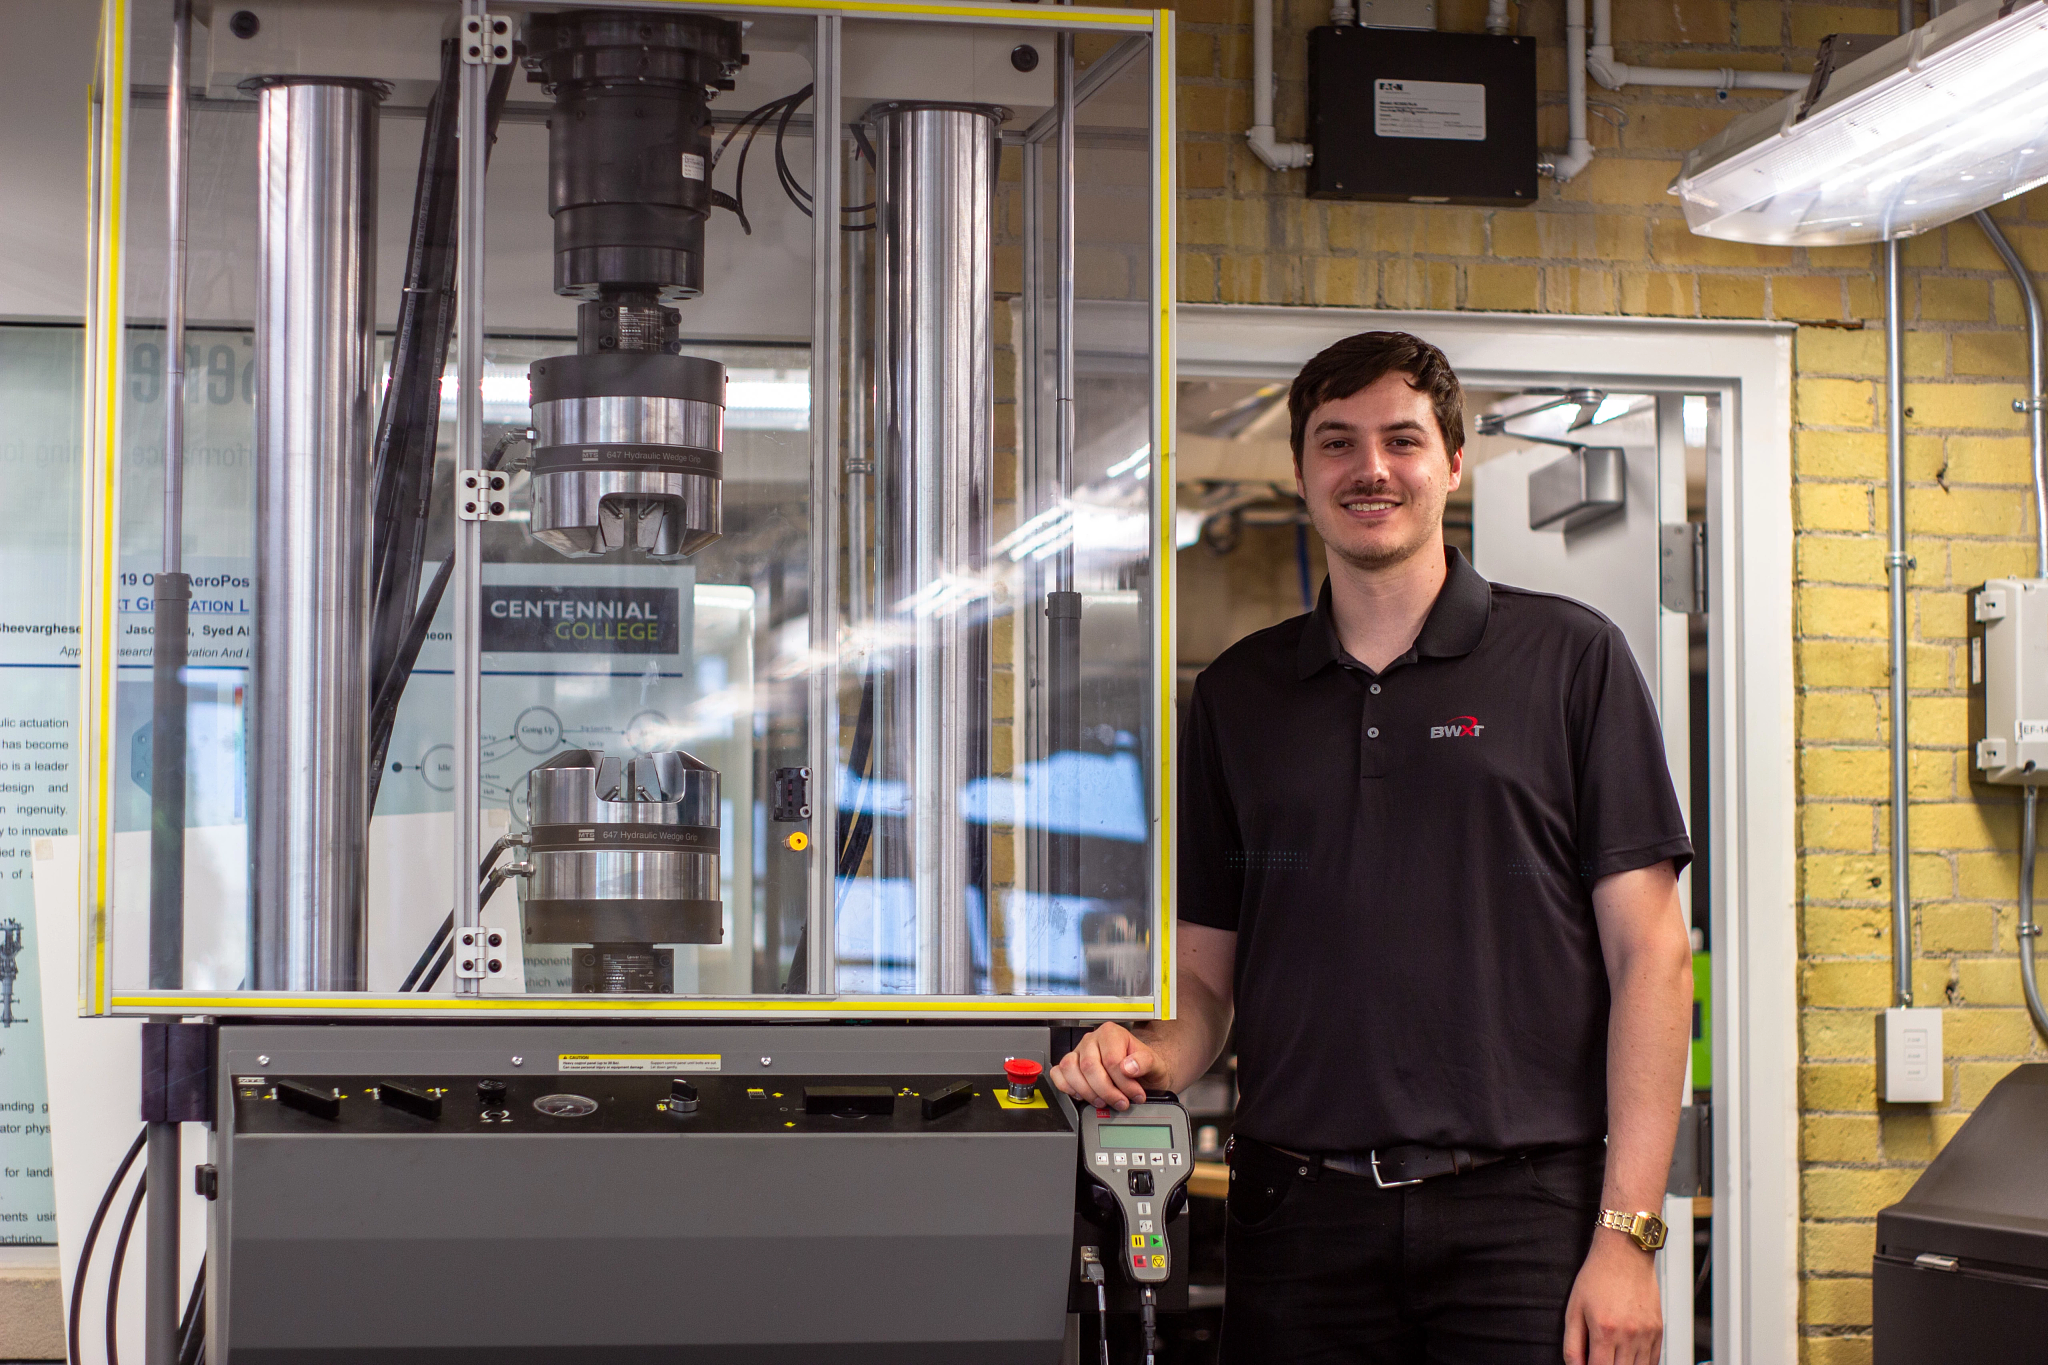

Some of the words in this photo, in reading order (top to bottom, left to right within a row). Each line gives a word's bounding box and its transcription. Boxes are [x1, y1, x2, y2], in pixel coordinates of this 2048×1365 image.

[582, 451, 598, 459] MTS
[606, 451, 621, 459] 647
[624, 451, 661, 461] Hydraulic
[662, 451, 687, 463] Wedge
[688, 454, 701, 465] Grip
[490, 599, 658, 619] CENTENNIAL
[202, 625, 233, 638] Syed
[555, 621, 658, 641] COLLEGE
[221, 647, 244, 659] And
[19, 717, 69, 729] actuation
[1430, 718, 1484, 739] BWXT
[2, 739, 21, 751] has
[25, 739, 69, 751] become
[12, 760, 21, 772] is
[24, 762, 31, 772] a
[34, 760, 69, 772] leader
[48, 782, 69, 793] and
[17, 803, 68, 817] ingenuity.
[8, 825, 19, 836] to
[21, 825, 69, 836] innovate
[578, 831, 595, 839] MTS
[602, 830, 618, 839] 647
[620, 830, 657, 842] Hydraulic
[659, 831, 683, 843] Wedge
[685, 832, 698, 844] Grip
[12, 868, 23, 880] of
[5, 1167, 20, 1178] for
